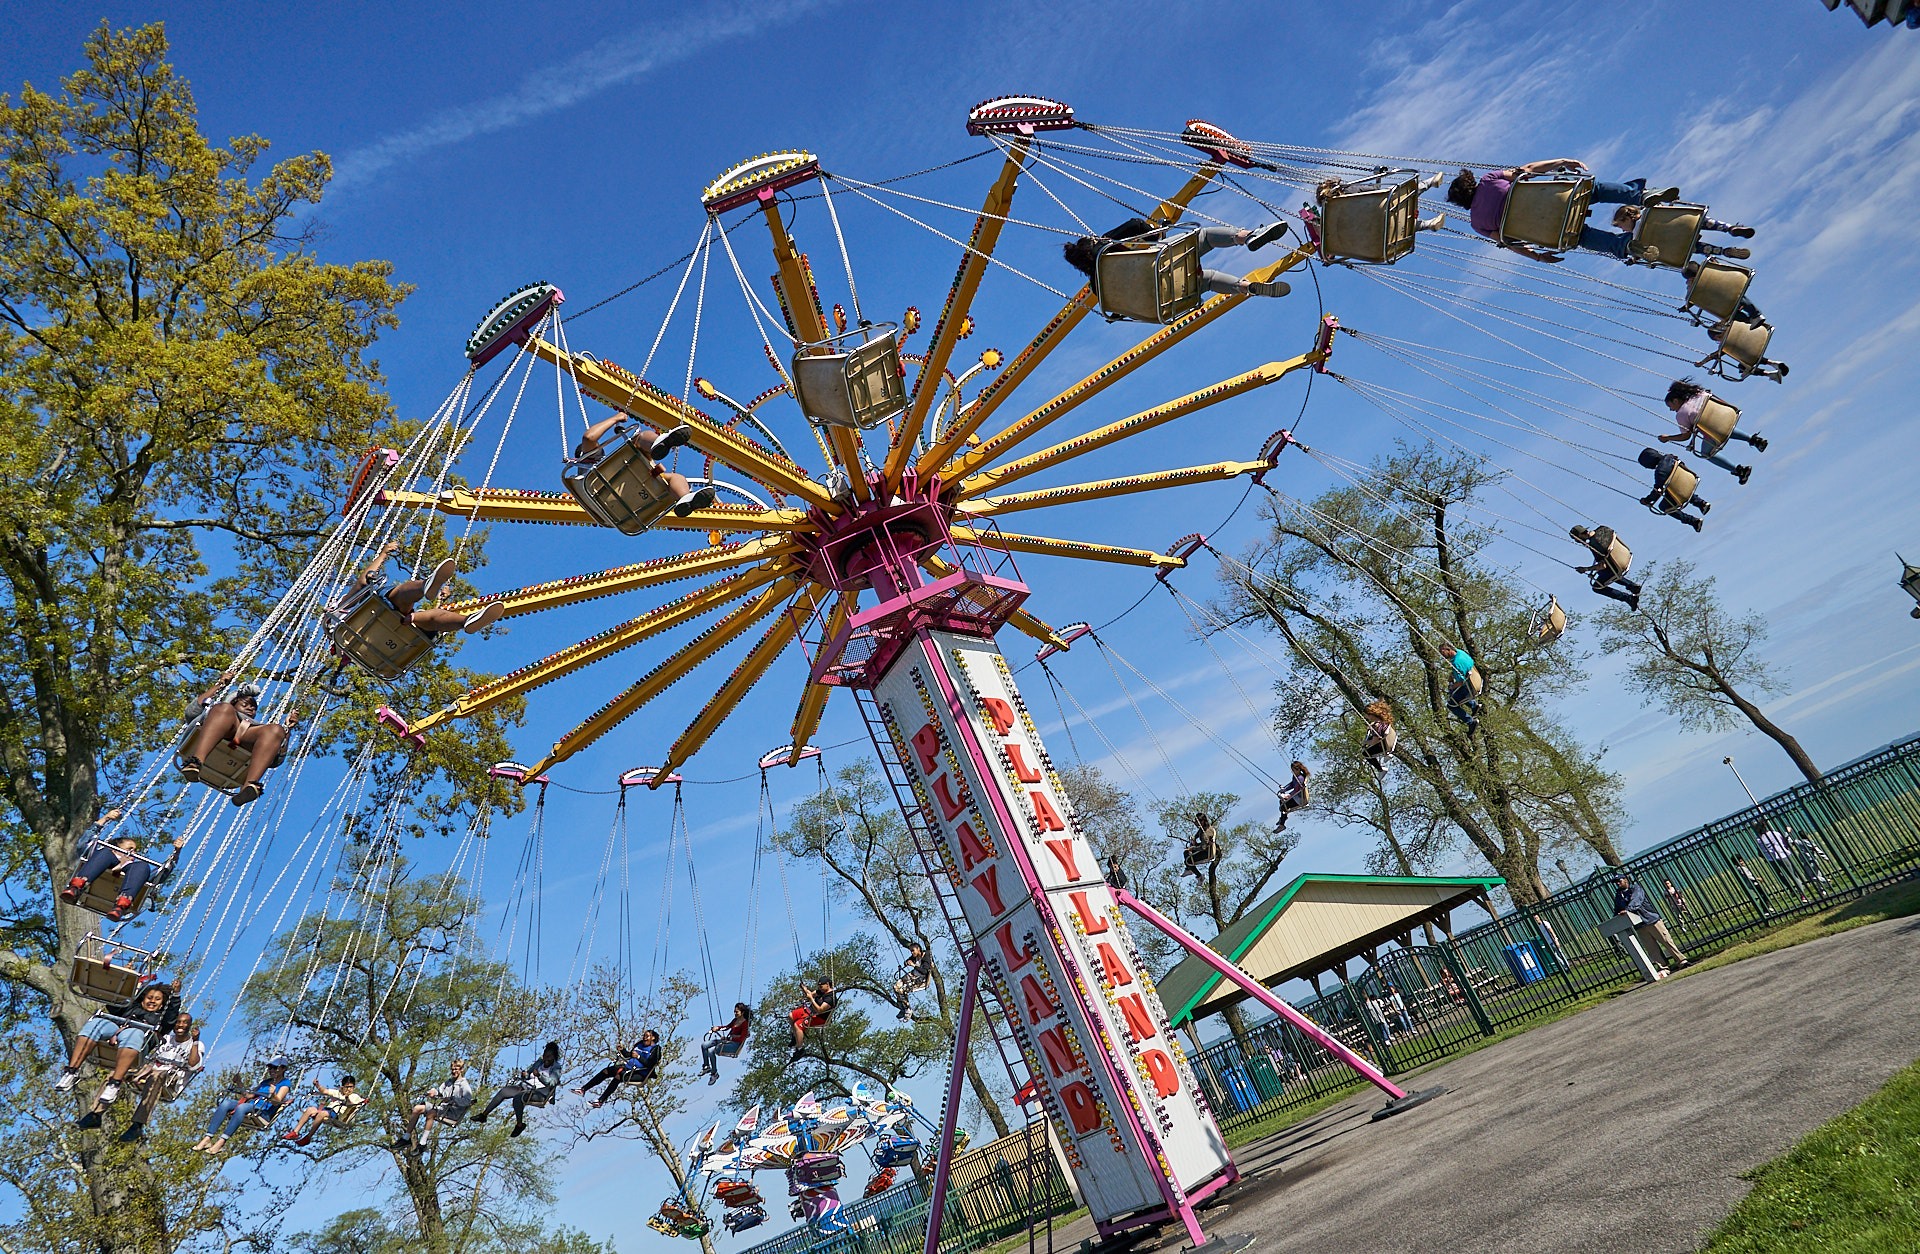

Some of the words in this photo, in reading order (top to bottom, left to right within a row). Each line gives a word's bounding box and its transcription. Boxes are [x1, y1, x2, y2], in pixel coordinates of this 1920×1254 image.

[638, 490, 649, 500] 29
[385, 639, 397, 650] 30
[227, 759, 238, 768] 31
[982, 697, 1180, 1099] PLAYLAND
[910, 723, 1102, 1135] PLAYLAND
